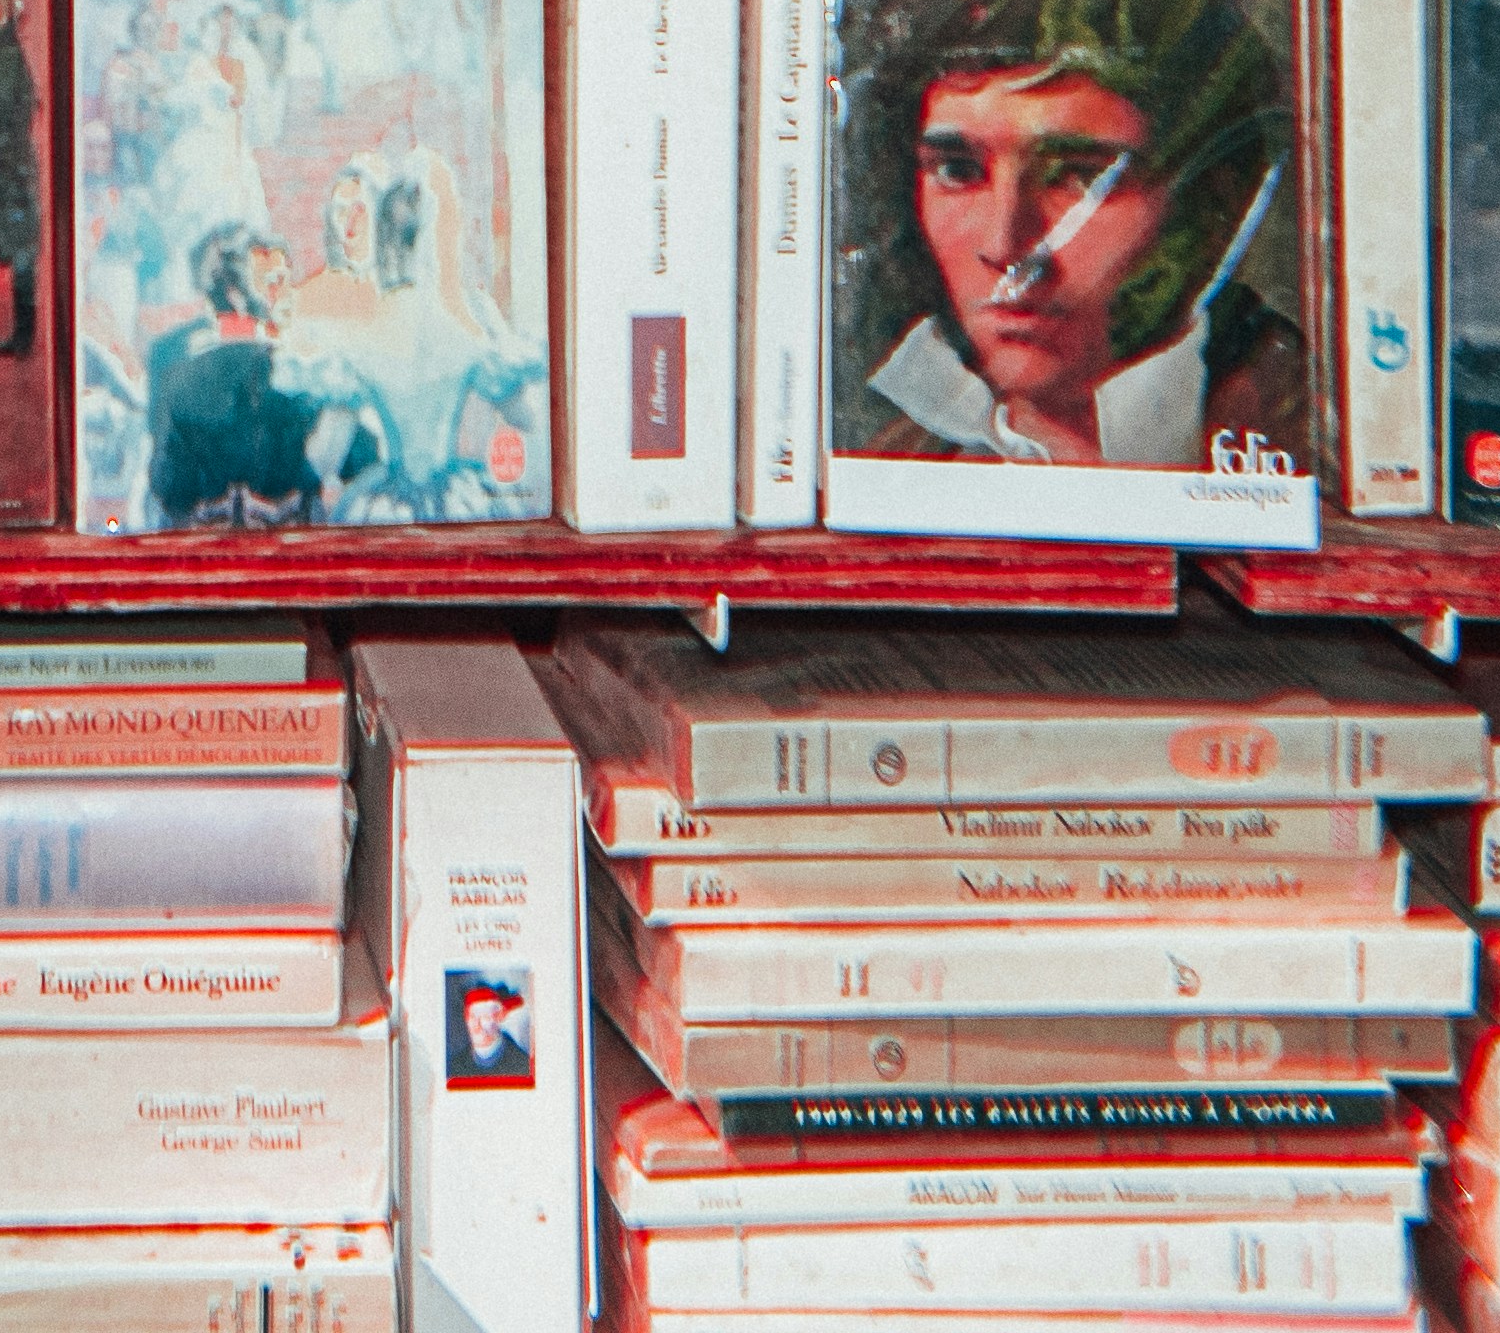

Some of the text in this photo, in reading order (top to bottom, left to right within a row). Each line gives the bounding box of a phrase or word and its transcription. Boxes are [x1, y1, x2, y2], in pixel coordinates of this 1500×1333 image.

[774, 165, 800, 257] Dumas
[1211, 425, 1297, 477] folio
[6, 707, 324, 736] RAYMOND QUENEAU
[1052, 807, 1156, 837] Nabokov
[446, 869, 529, 889] FRANÇOIS
[957, 868, 1080, 901] Nabokov
[448, 890, 529, 908] RABELAIS
[38, 966, 137, 1003] Eugène
[142, 964, 281, 1001] Oniéguine
[136, 1093, 329, 1125] Gustave Flaubert
[160, 1125, 305, 1155] George Sand
